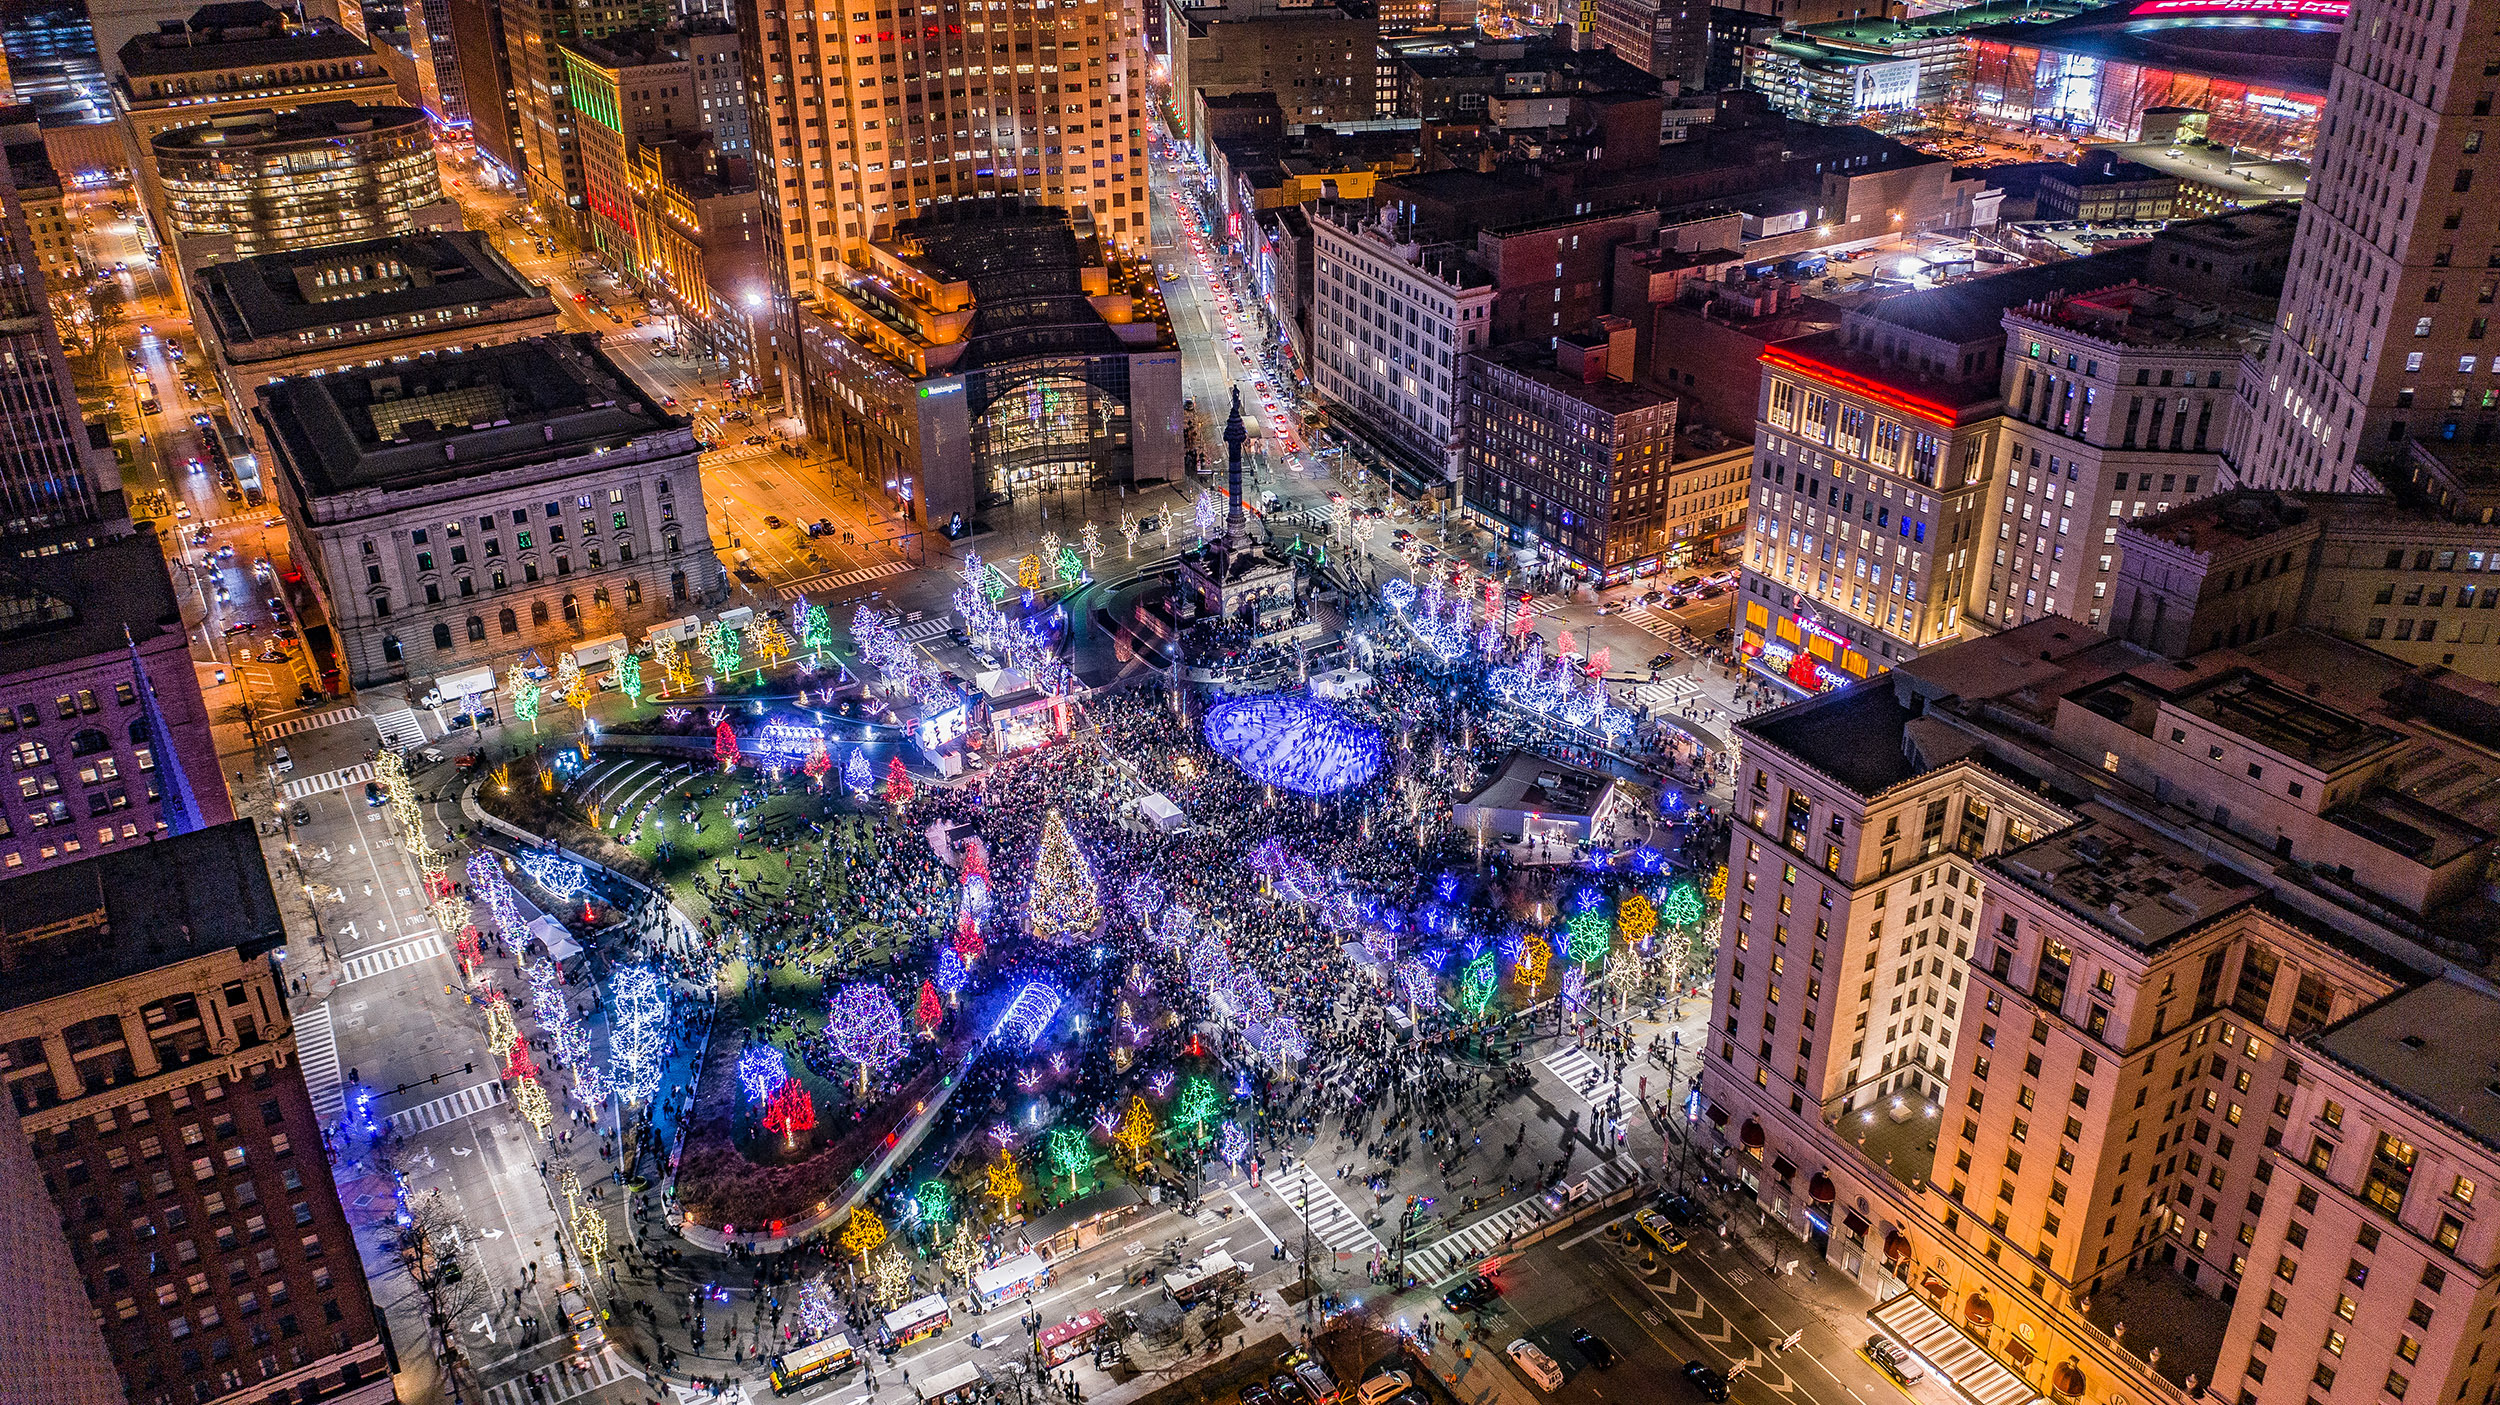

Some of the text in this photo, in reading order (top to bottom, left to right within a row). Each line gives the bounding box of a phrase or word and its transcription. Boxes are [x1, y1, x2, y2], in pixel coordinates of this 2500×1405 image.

[1682, 502, 1740, 523] SOUTHWORTH
[1796, 617, 1845, 645] JACK CASINO
[367, 812, 382, 822] BUS
[375, 838, 395, 849] ONLY
[396, 887, 412, 898] BUS
[404, 915, 426, 927] ONLY
[490, 1123, 508, 1137] BUS
[543, 1251, 563, 1268] BUS
[1937, 1258, 1947, 1273] R
[1727, 1267, 1753, 1287] BUS
[1002, 1281, 1028, 1296] GYRO
[1641, 1306, 1668, 1326] BUS
[801, 1368, 822, 1380] STREET
